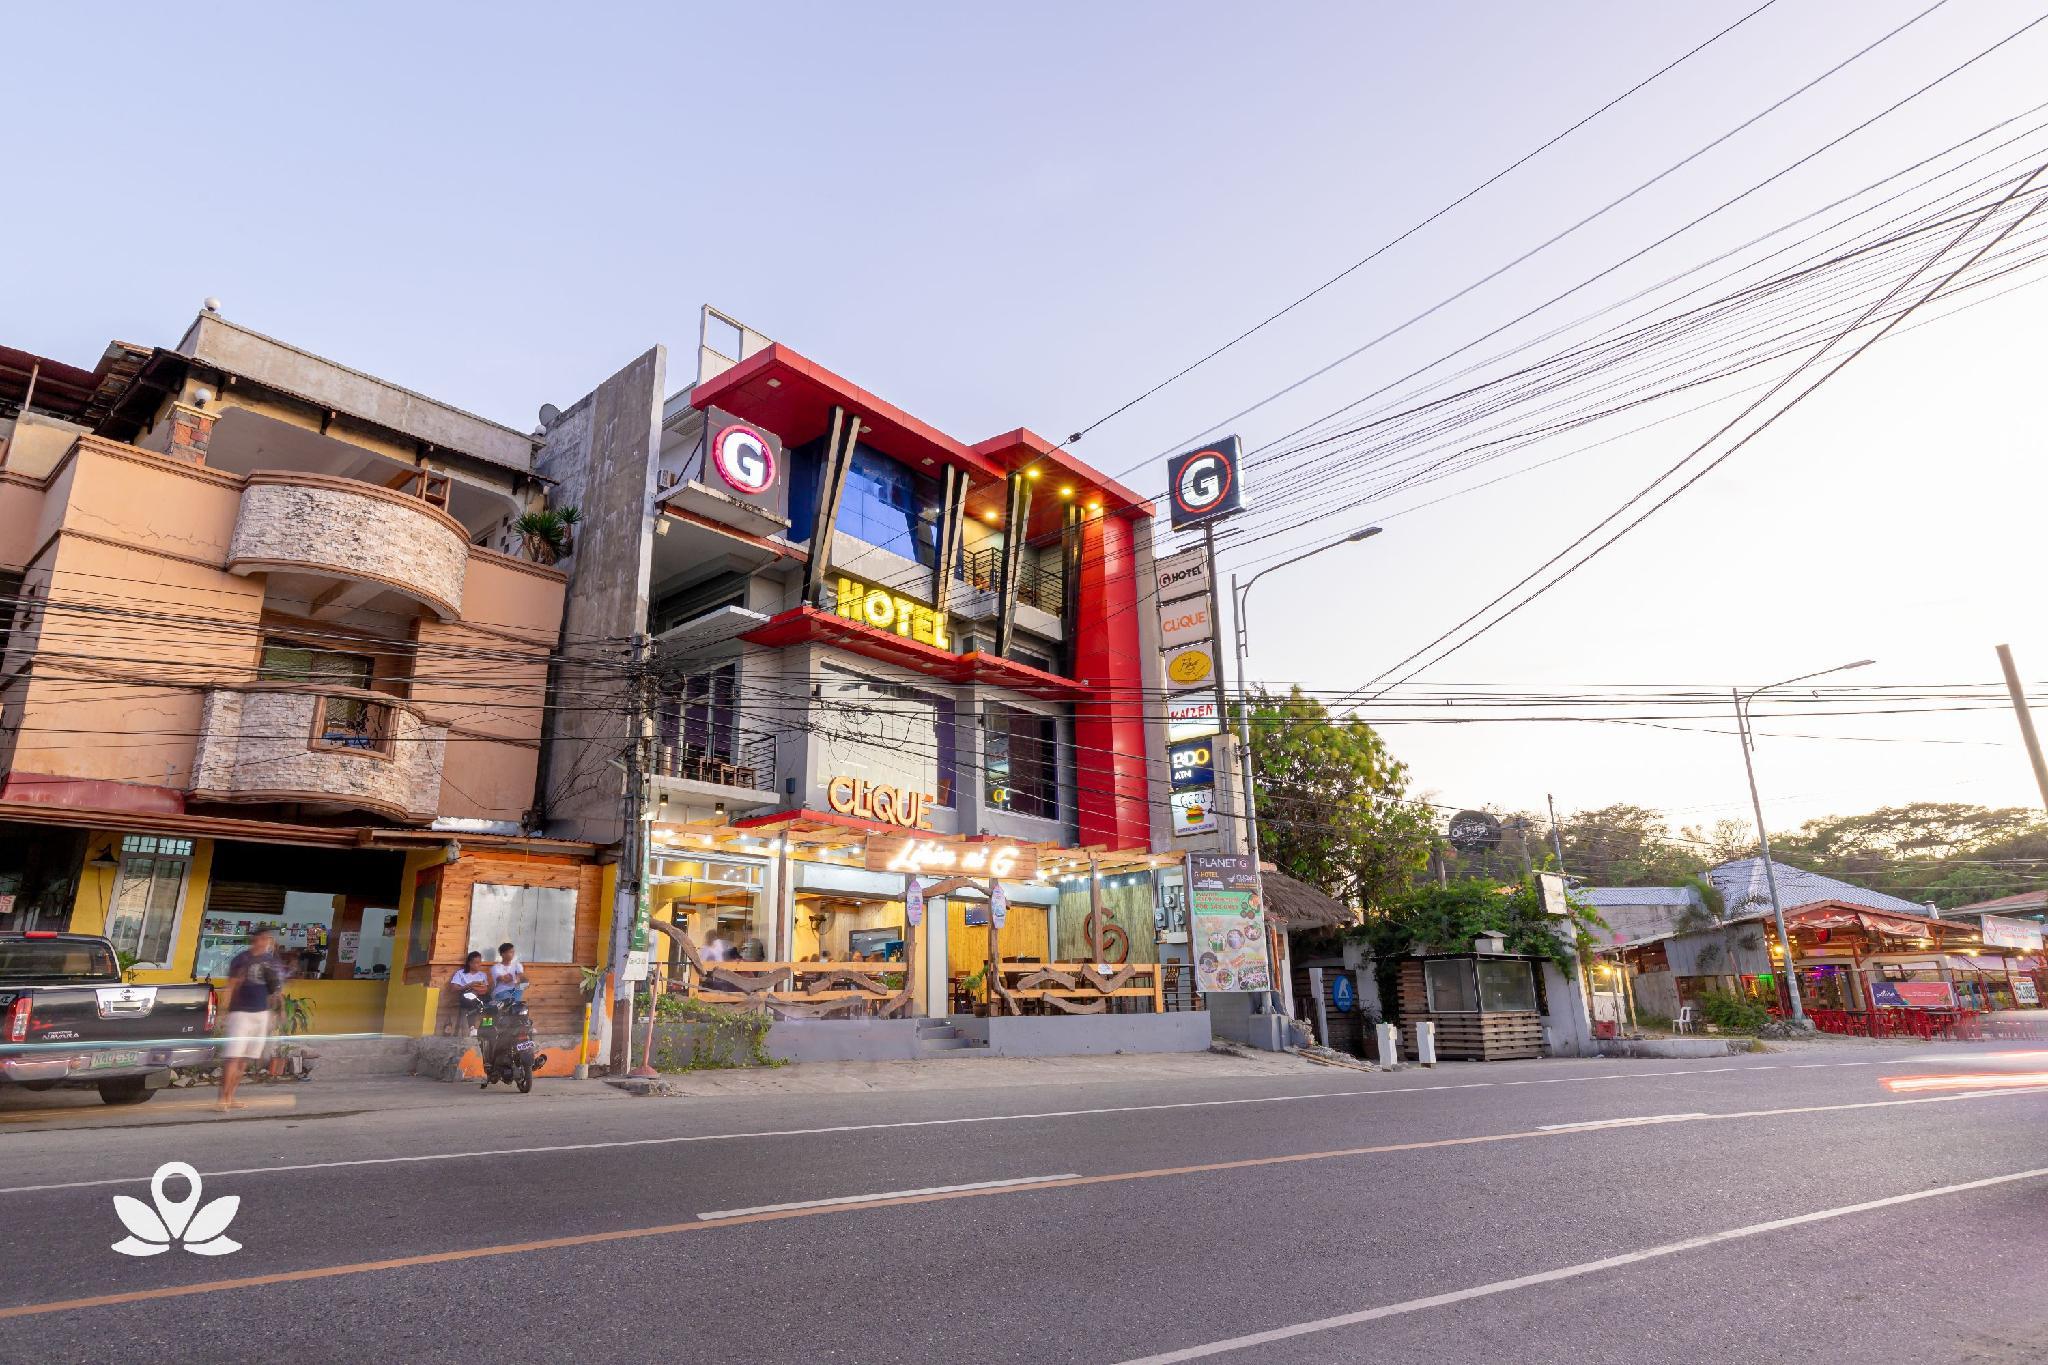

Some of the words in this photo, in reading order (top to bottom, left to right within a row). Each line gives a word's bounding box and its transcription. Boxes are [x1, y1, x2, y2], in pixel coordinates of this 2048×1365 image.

[721, 431, 765, 488] G
[1181, 457, 1220, 506] G
[1171, 565, 1202, 582] HOTEL
[837, 577, 950, 650] HOTEL
[1170, 703, 1214, 722] KAIZEN
[1173, 750, 1210, 769] BDO
[1174, 769, 1192, 780] ATM
[1200, 858, 1237, 868] PLANET
[1239, 859, 1248, 869] G
